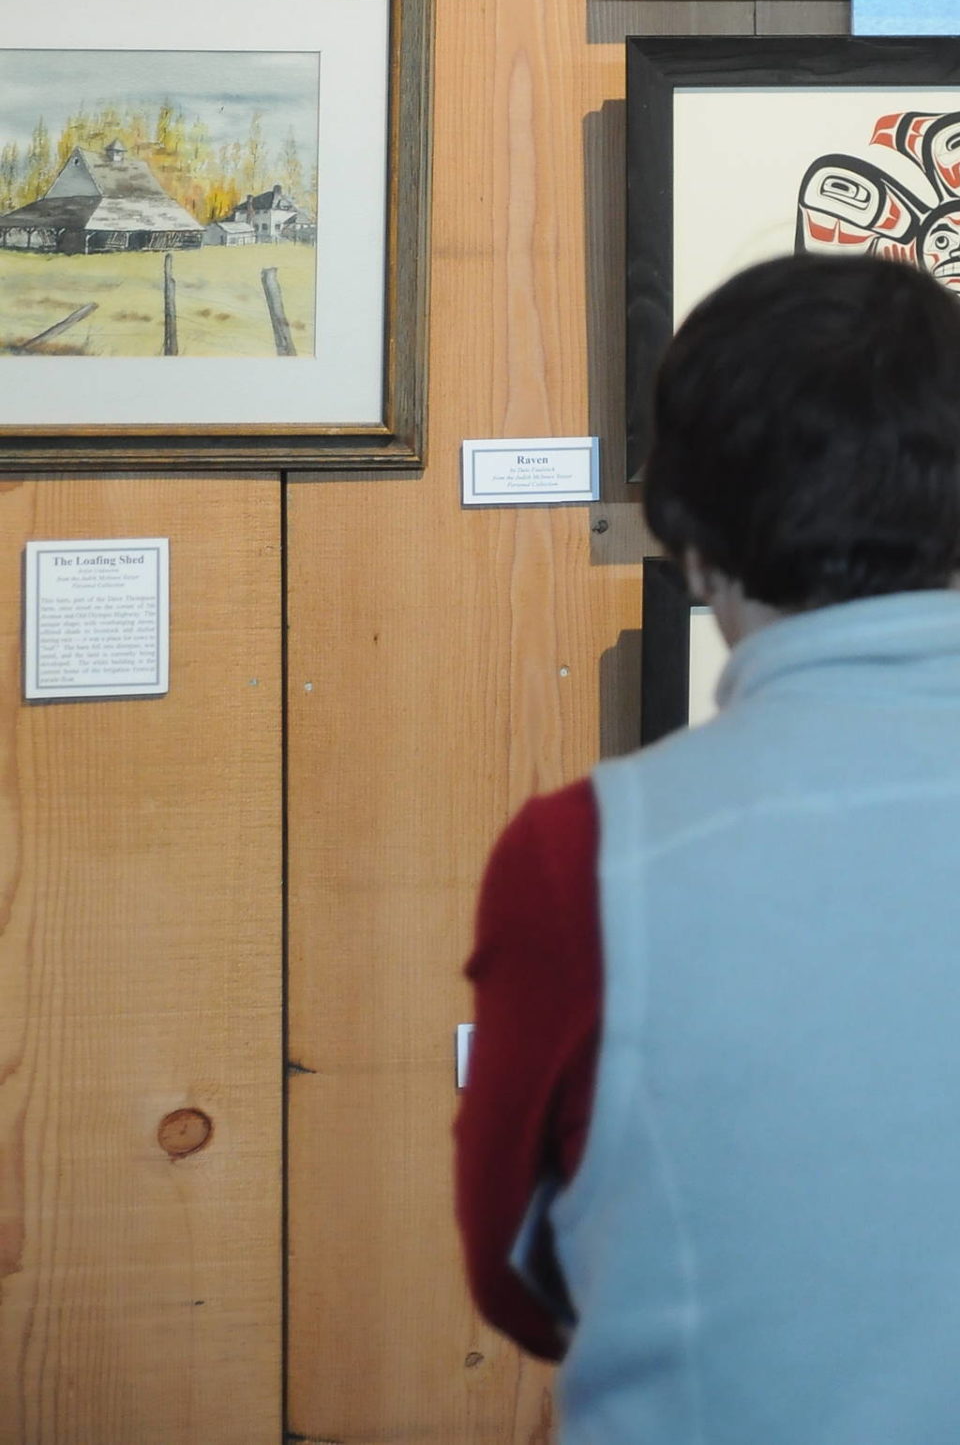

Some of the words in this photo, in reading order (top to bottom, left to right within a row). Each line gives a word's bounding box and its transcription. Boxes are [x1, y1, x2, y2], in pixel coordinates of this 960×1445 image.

[517, 455, 549, 465] Raven
[54, 556, 73, 566] The
[76, 555, 116, 567] Loafing
[119, 554, 145, 565] Shed
